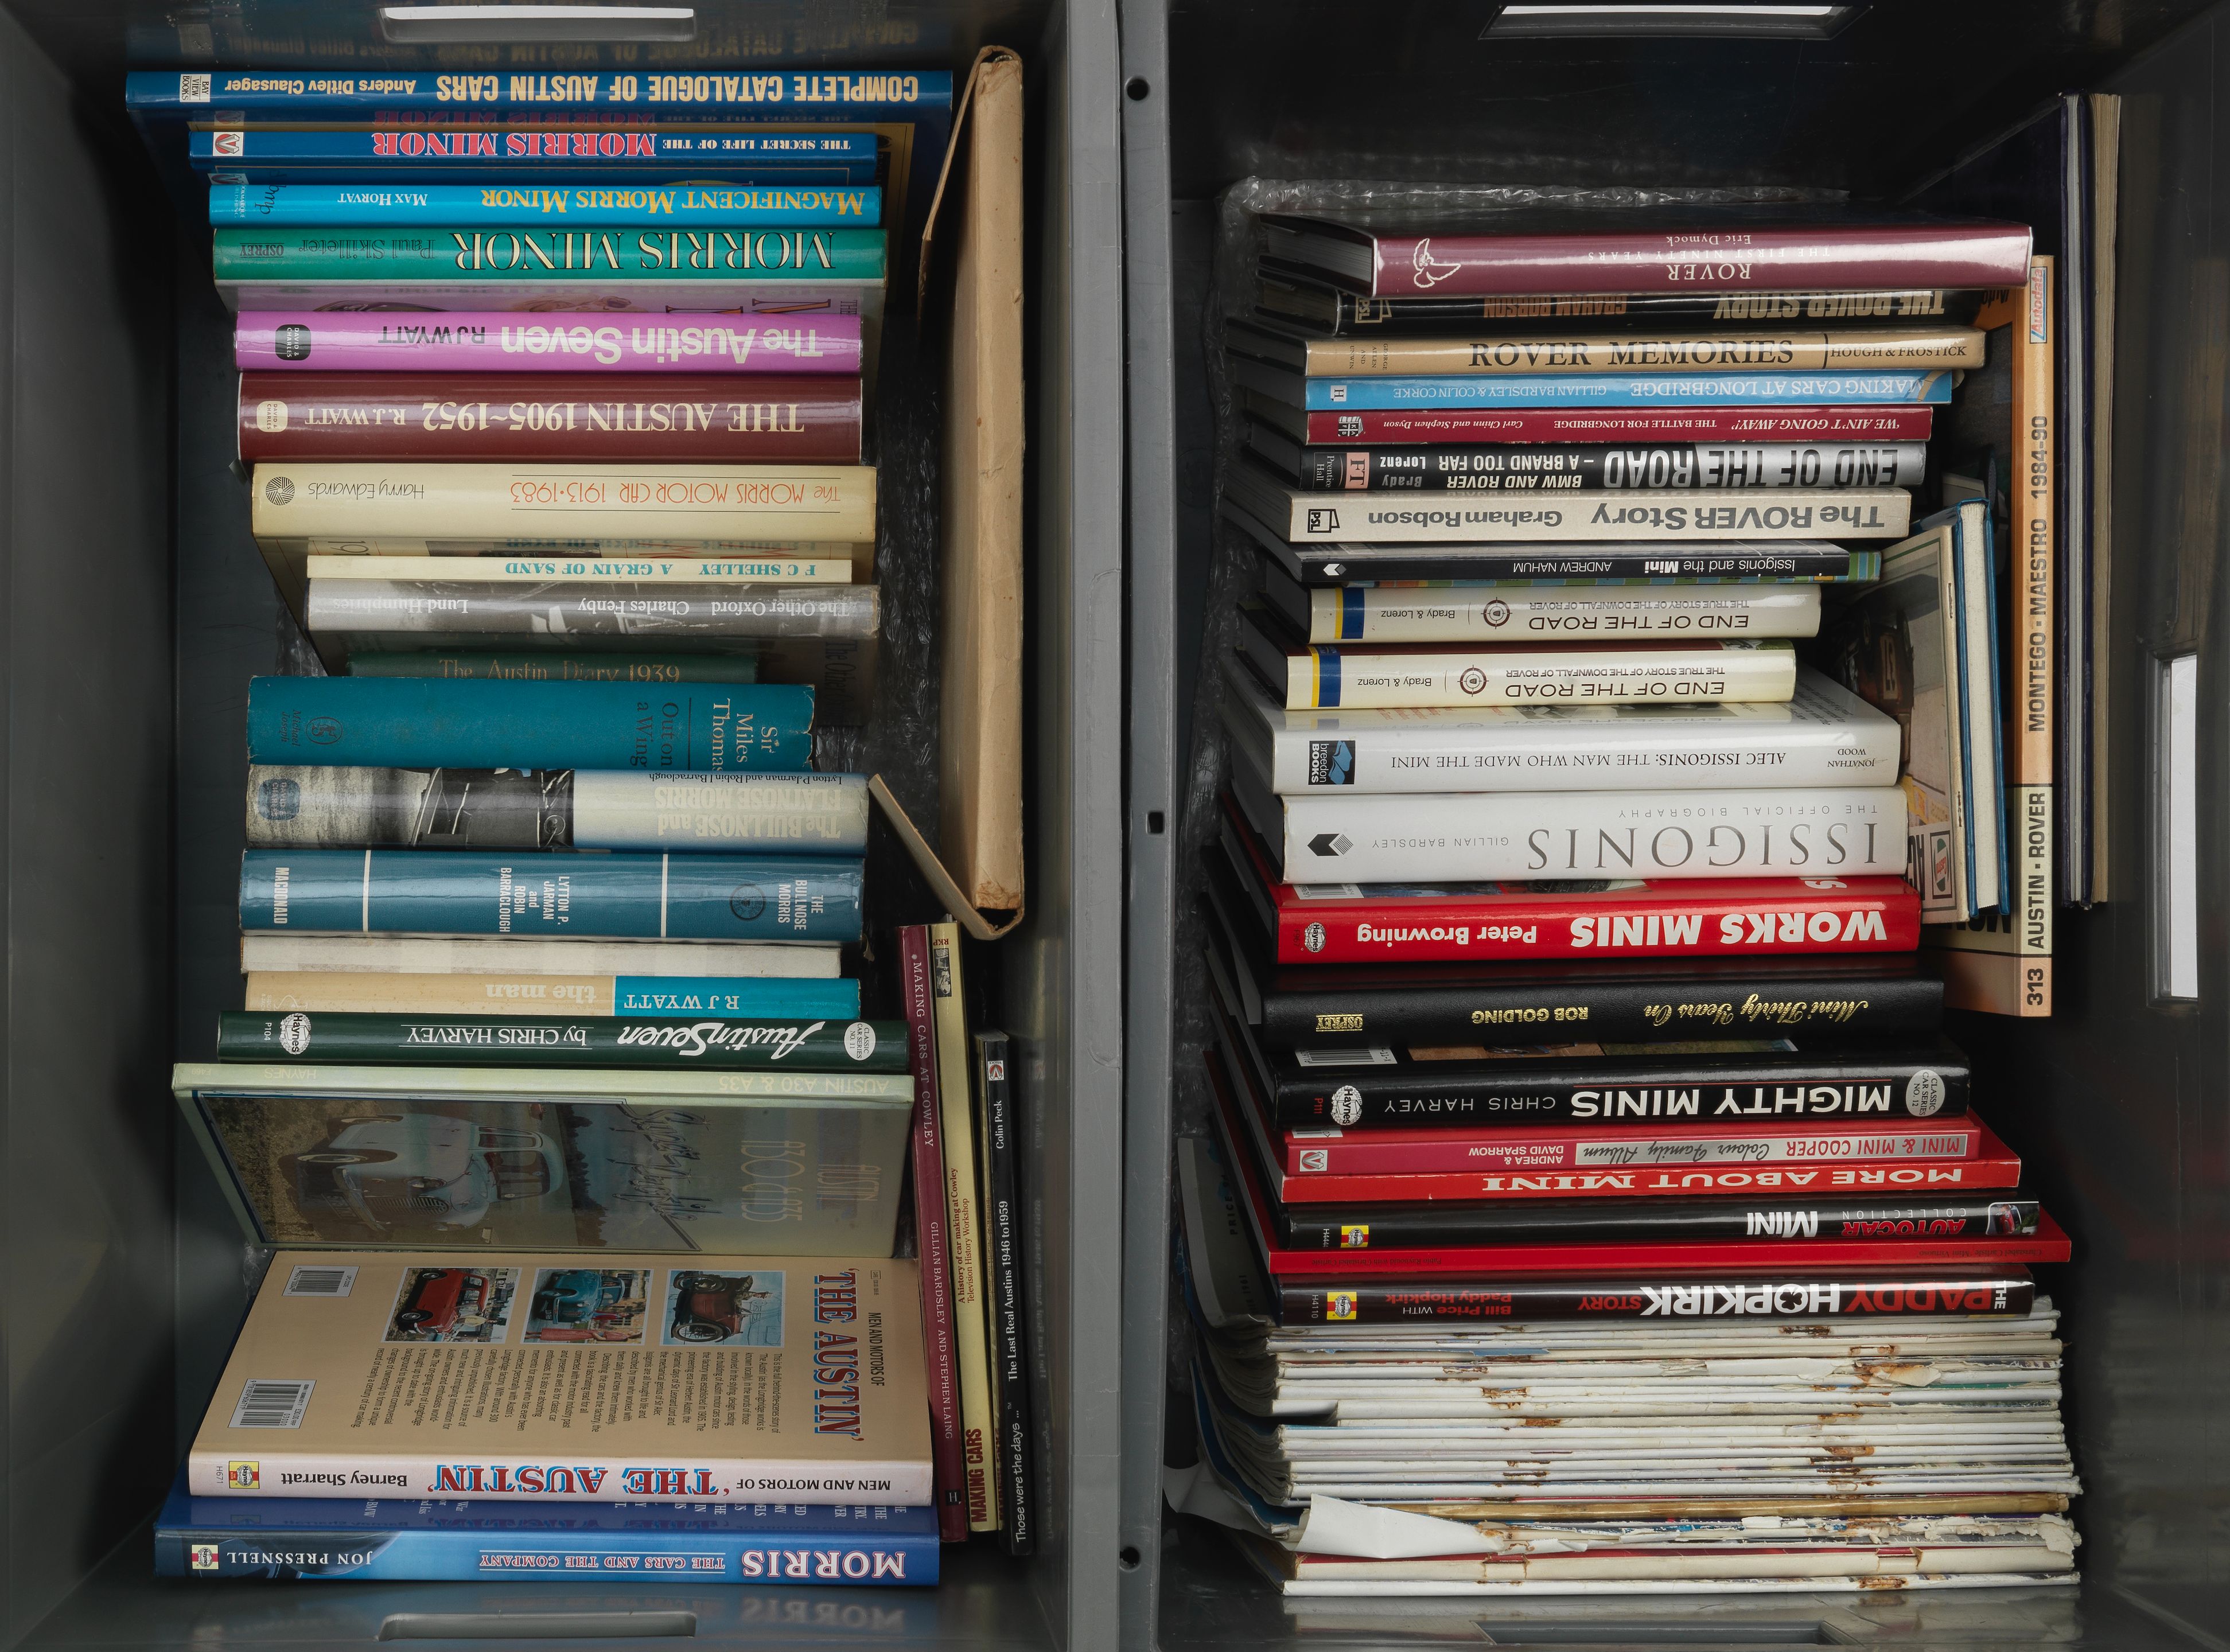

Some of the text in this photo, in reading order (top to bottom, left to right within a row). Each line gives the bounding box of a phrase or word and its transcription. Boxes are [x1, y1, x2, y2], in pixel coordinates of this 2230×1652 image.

[225, 77, 417, 95] Anders Ditlev Clausager
[437, 75, 919, 102] COMPLETE CATALOGUE OF AUSTIN CARS
[371, 133, 850, 157] THE SECRET LIFE OF THE MORRIS MINOR
[337, 193, 427, 206] MAX HORVAT
[481, 190, 865, 216] MAGNIFICENT MORRIS MINOR
[1666, 233, 1752, 245] Eric Dymock
[239, 244, 284, 257] OSPREY
[449, 232, 836, 271] MORRIS MINOR
[1666, 263, 1752, 280] ROVER
[2030, 268, 2046, 334] Autodata
[501, 326, 823, 364] The Austin Seven
[1469, 341, 1793, 367] ROVER MEMORIES
[1831, 346, 1967, 358] HOUGH & FROSTICK
[1630, 380, 1841, 396] CARS AT LONGBRIDGE
[585, 403, 718, 431] AUSTIN
[727, 403, 804, 432] THE
[1383, 419, 1412, 429] Dyson
[1414, 419, 1450, 428] Stephen
[1604, 449, 1898, 488] END OF THE ROAD
[308, 479, 425, 500] Harry Edwards
[618, 482, 840, 504] The MORRIS MOTOR CAR
[1311, 512, 1321, 531] PSL
[1368, 511, 1562, 527] Graham Robson
[1591, 504, 1884, 530] The ROVER Story
[505, 563, 672, 575] A GRAIN OF SAND
[699, 564, 815, 575] F C SHELLEY
[1513, 562, 1612, 572] ANDREW NAHUM
[1645, 558, 1795, 573] Issigonis and the Mini
[2029, 416, 2048, 732] MONTEGO MAESTRO 1984-90
[578, 597, 689, 615] Charles Fenby
[711, 601, 849, 617] The Other Oxford
[1357, 676, 1431, 687] Brady & Lorenz
[736, 713, 753, 763] Miles
[761, 726, 777, 753] Sir
[1311, 743, 1320, 783] BOOKS
[1320, 743, 1329, 782] breedon
[1391, 753, 1786, 768] ALEC ISSIGONIS: THE MAN WHO MADE THE MINI
[1618, 805, 1877, 818] THE OFFICIAL BIOGRAPHY
[1527, 823, 1877, 870] ISSIGONIS
[2027, 793, 2045, 949] AUSTIN ROVER
[274, 867, 289, 924] MACDONALD
[778, 885, 791, 924] MORRIS
[794, 880, 807, 930] BULLNOSE
[811, 895, 823, 913] THE
[1357, 924, 1536, 947] Peter Browning
[1570, 911, 1887, 948] WORKS MINIS
[2027, 968, 2044, 1006] 313
[1472, 1007, 1589, 1024] ROB GOLDING
[291, 1014, 303, 1053] Haynes
[407, 1027, 586, 1046] by CHRIS HARVEY
[1384, 1096, 1556, 1112] CHRIS HARVEY
[1571, 1085, 1891, 1117] MIGHTY MINIS
[994, 1100, 1005, 1149] Colin Peck
[1786, 1138, 1960, 1156] MINI & MINI COOPER
[1482, 1168, 1962, 1191] MORE ABOUT MINI
[1842, 1207, 1967, 1218] COLLECTION
[1746, 1211, 1818, 1237] MINI
[1841, 1218, 1967, 1237] AUTOCAR
[1578, 1296, 1642, 1310] STORY
[1844, 1281, 1991, 1312] PADDY
[931, 1222, 952, 1439] GILLIAN BARDSLEY AND STEPHEN LAING
[281, 1470, 407, 1487] Barney Sharratt
[736, 1478, 755, 1489] OF
[758, 1479, 819, 1490] MOTORS
[823, 1479, 854, 1490] AND
[858, 1479, 890, 1490] MEN
[966, 1429, 987, 1522] MAKING CARS
[1011, 1423, 1026, 1542] Those were the days
[227, 1551, 373, 1565] JON PRESSNELL
[478, 1554, 725, 1569] THE CARS AND THE COMPANY
[741, 1550, 906, 1579] MORRIS
